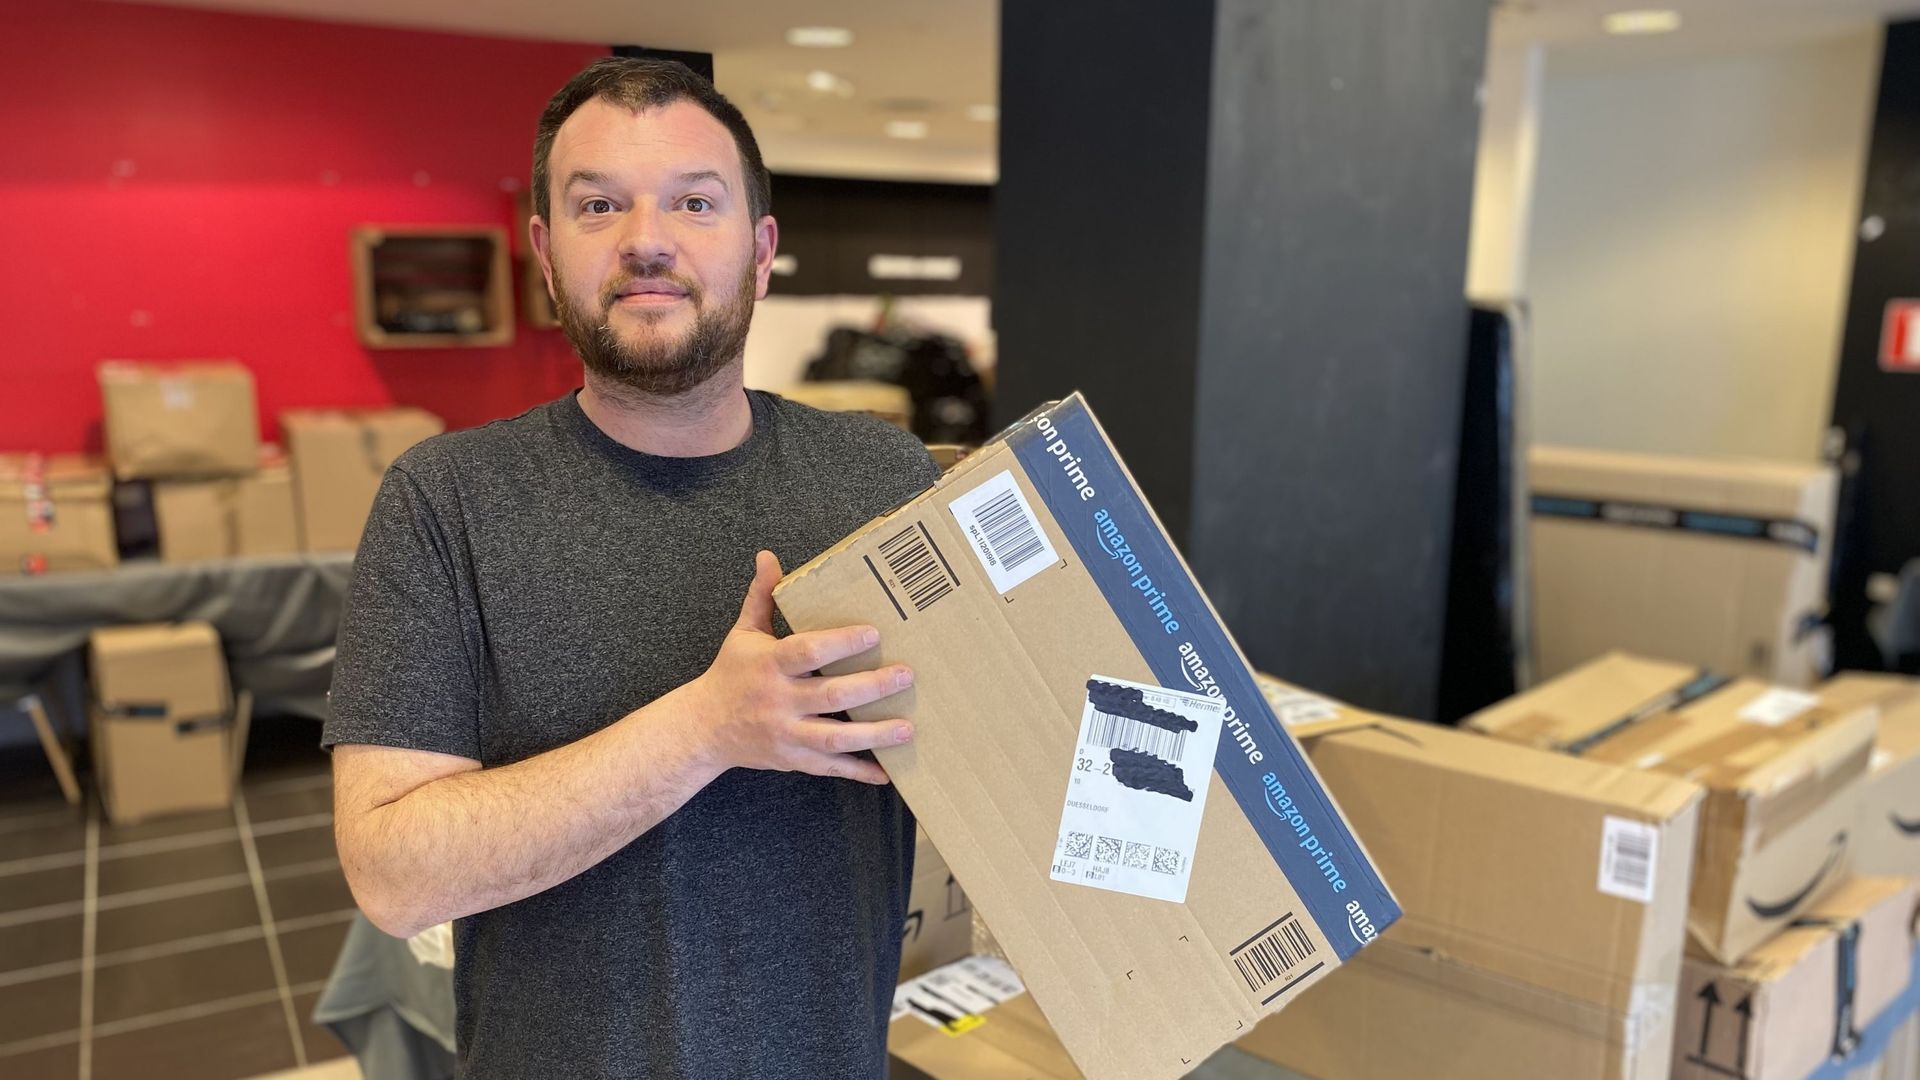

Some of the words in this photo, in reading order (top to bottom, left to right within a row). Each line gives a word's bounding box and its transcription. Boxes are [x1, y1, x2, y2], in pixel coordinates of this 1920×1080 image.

[1046, 439, 1096, 502] prime
[1094, 509, 1143, 577] amazon
[1131, 574, 1180, 634] prime
[1262, 772, 1310, 837] amazon
[1299, 835, 1347, 893] prime
